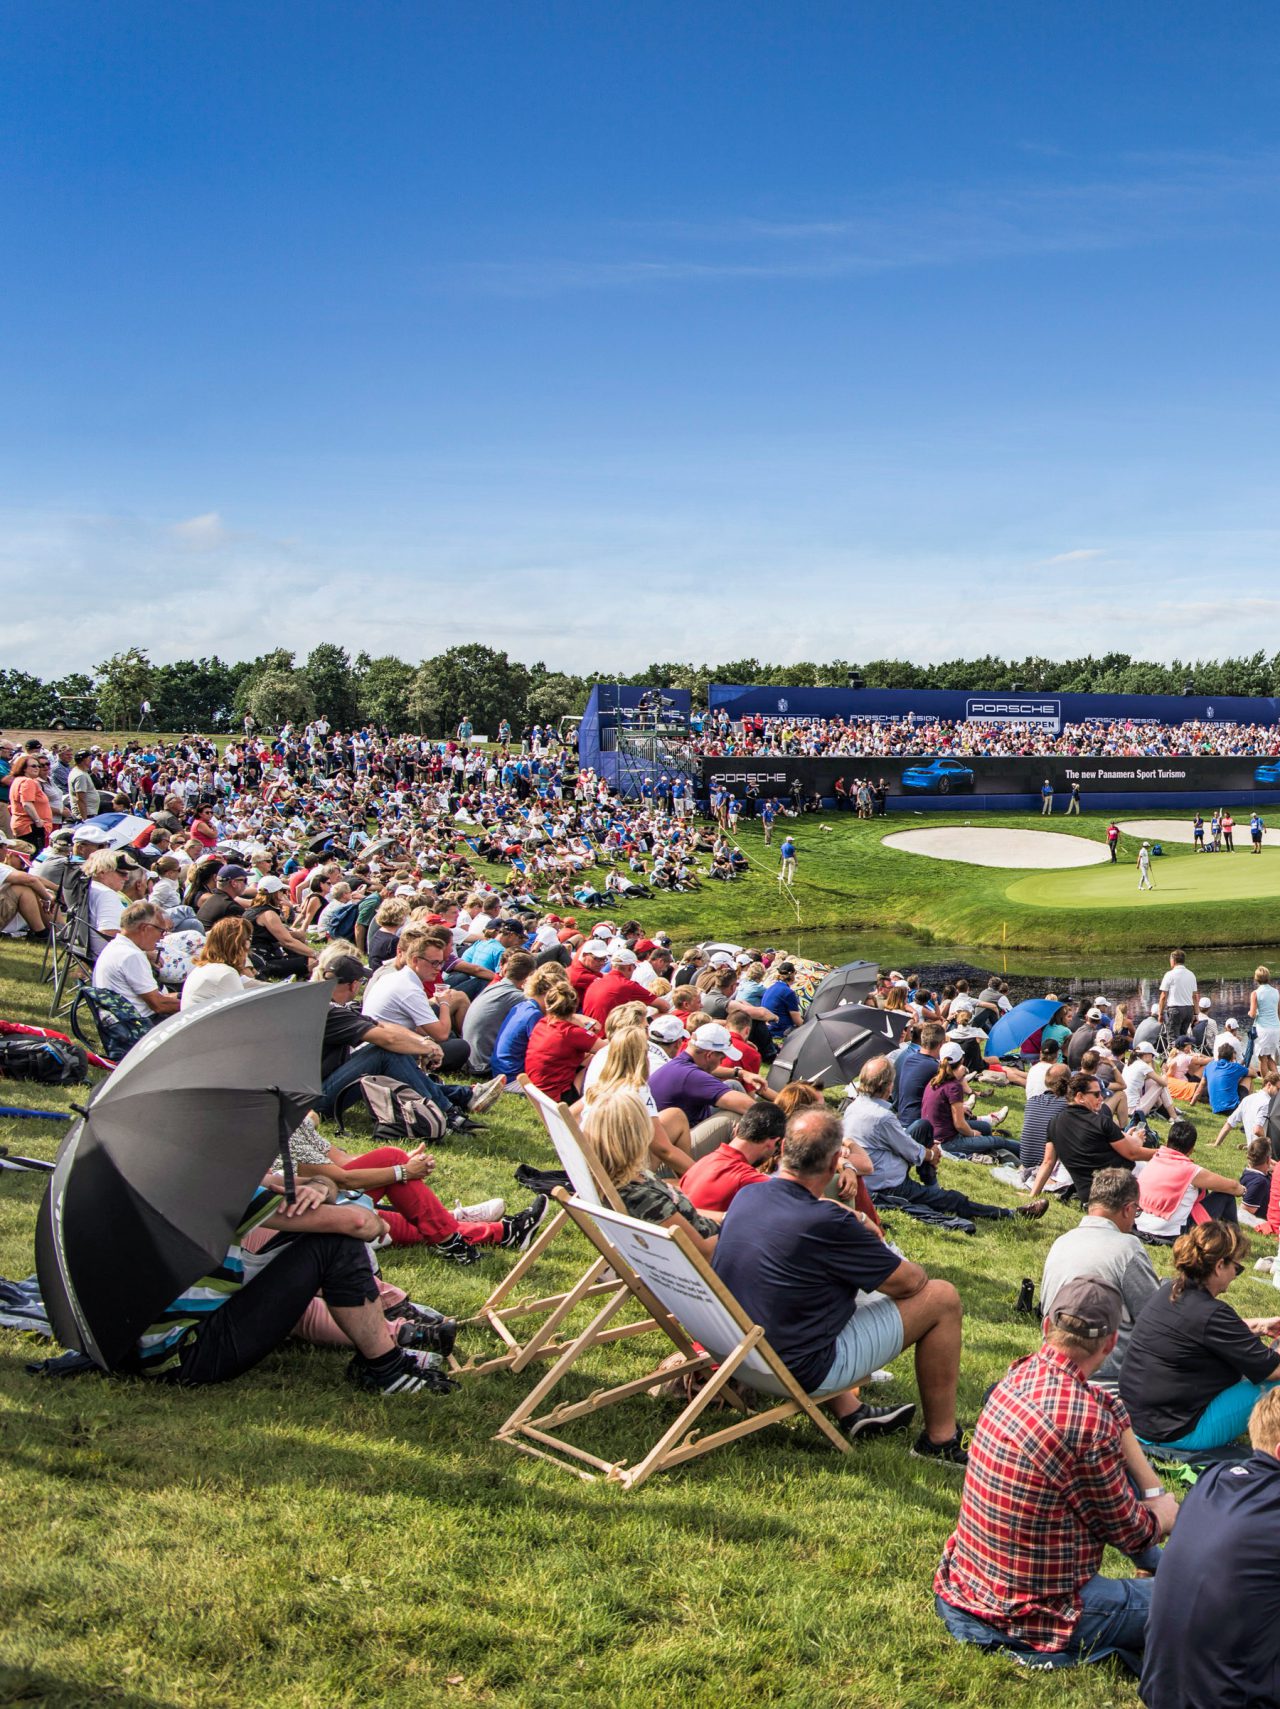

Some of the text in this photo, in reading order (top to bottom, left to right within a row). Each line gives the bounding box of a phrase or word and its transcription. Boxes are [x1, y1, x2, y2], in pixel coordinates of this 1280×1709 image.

[971, 704, 1055, 714] PORSCHE
[714, 772, 787, 783] PORSCHE
[1065, 769, 1080, 778] The
[1098, 769, 1135, 778] Panamera
[1136, 769, 1156, 779] Sport
[1157, 769, 1186, 778] Turismo
[646, 1096, 654, 1109] 4
